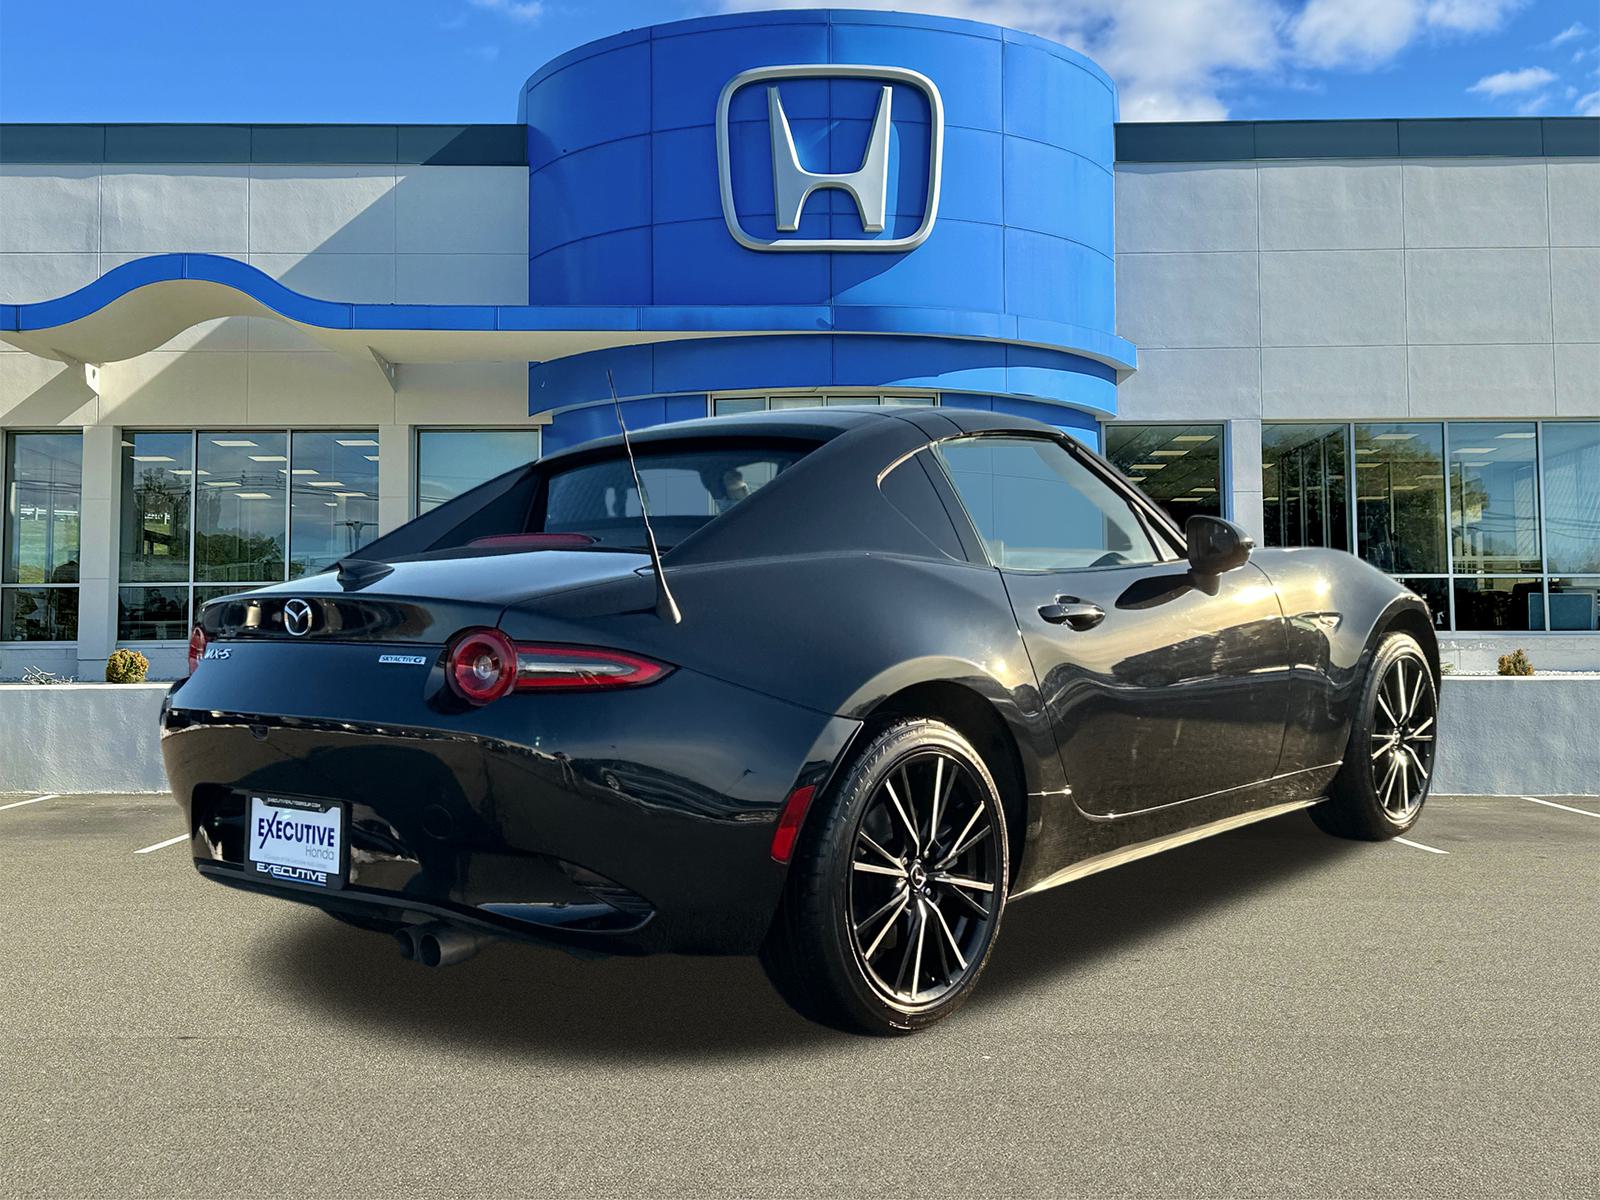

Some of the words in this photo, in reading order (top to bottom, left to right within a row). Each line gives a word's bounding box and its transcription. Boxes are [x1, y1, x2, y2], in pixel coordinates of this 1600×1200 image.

[258, 811, 335, 848] EXECUTIVE
[305, 845, 335, 861] Honda
[256, 862, 327, 883] EXECUTIVE
